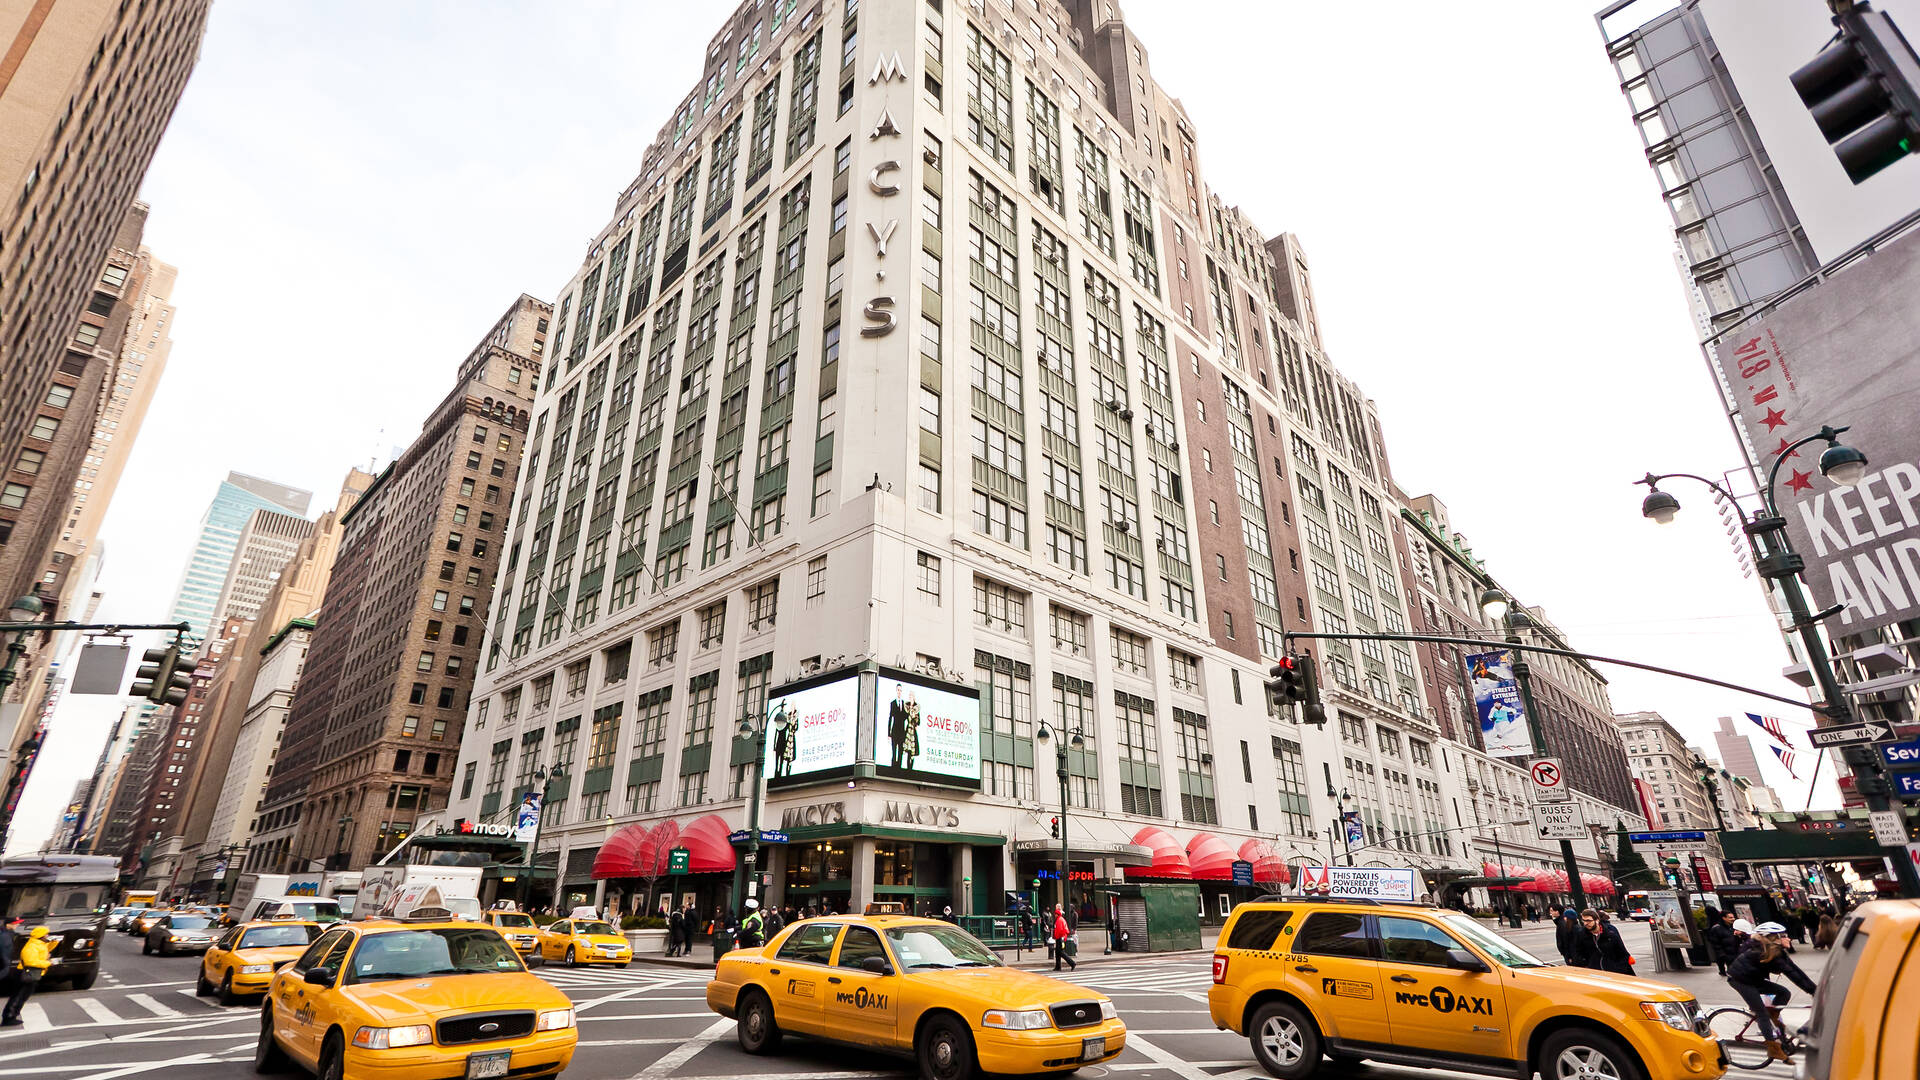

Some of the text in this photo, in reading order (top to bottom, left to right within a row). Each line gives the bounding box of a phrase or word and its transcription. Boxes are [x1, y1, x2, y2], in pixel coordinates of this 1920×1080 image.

[803, 711, 826, 729] SAVE
[926, 714, 952, 731] SAVE
[954, 720, 973, 736] 60%
[1820, 727, 1880, 742] ONE WAY
[926, 747, 974, 761] SALE SATURDAY
[781, 801, 847, 828] MACY'S
[881, 800, 960, 828] MACY'S
[1540, 805, 1573, 815] BUSES
[1545, 815, 1571, 824] ONLY
[1332, 872, 1351, 880] THIS
[1352, 872, 1370, 880] TAXI
[1333, 879, 1368, 887] POWERED
[1331, 885, 1379, 895] GNOMES
[1284, 954, 1309, 963] 2V85
[836, 986, 888, 1010] NYC TAXI
[1395, 991, 1429, 1007] NYC
[1429, 985, 1493, 1016] TAXI
